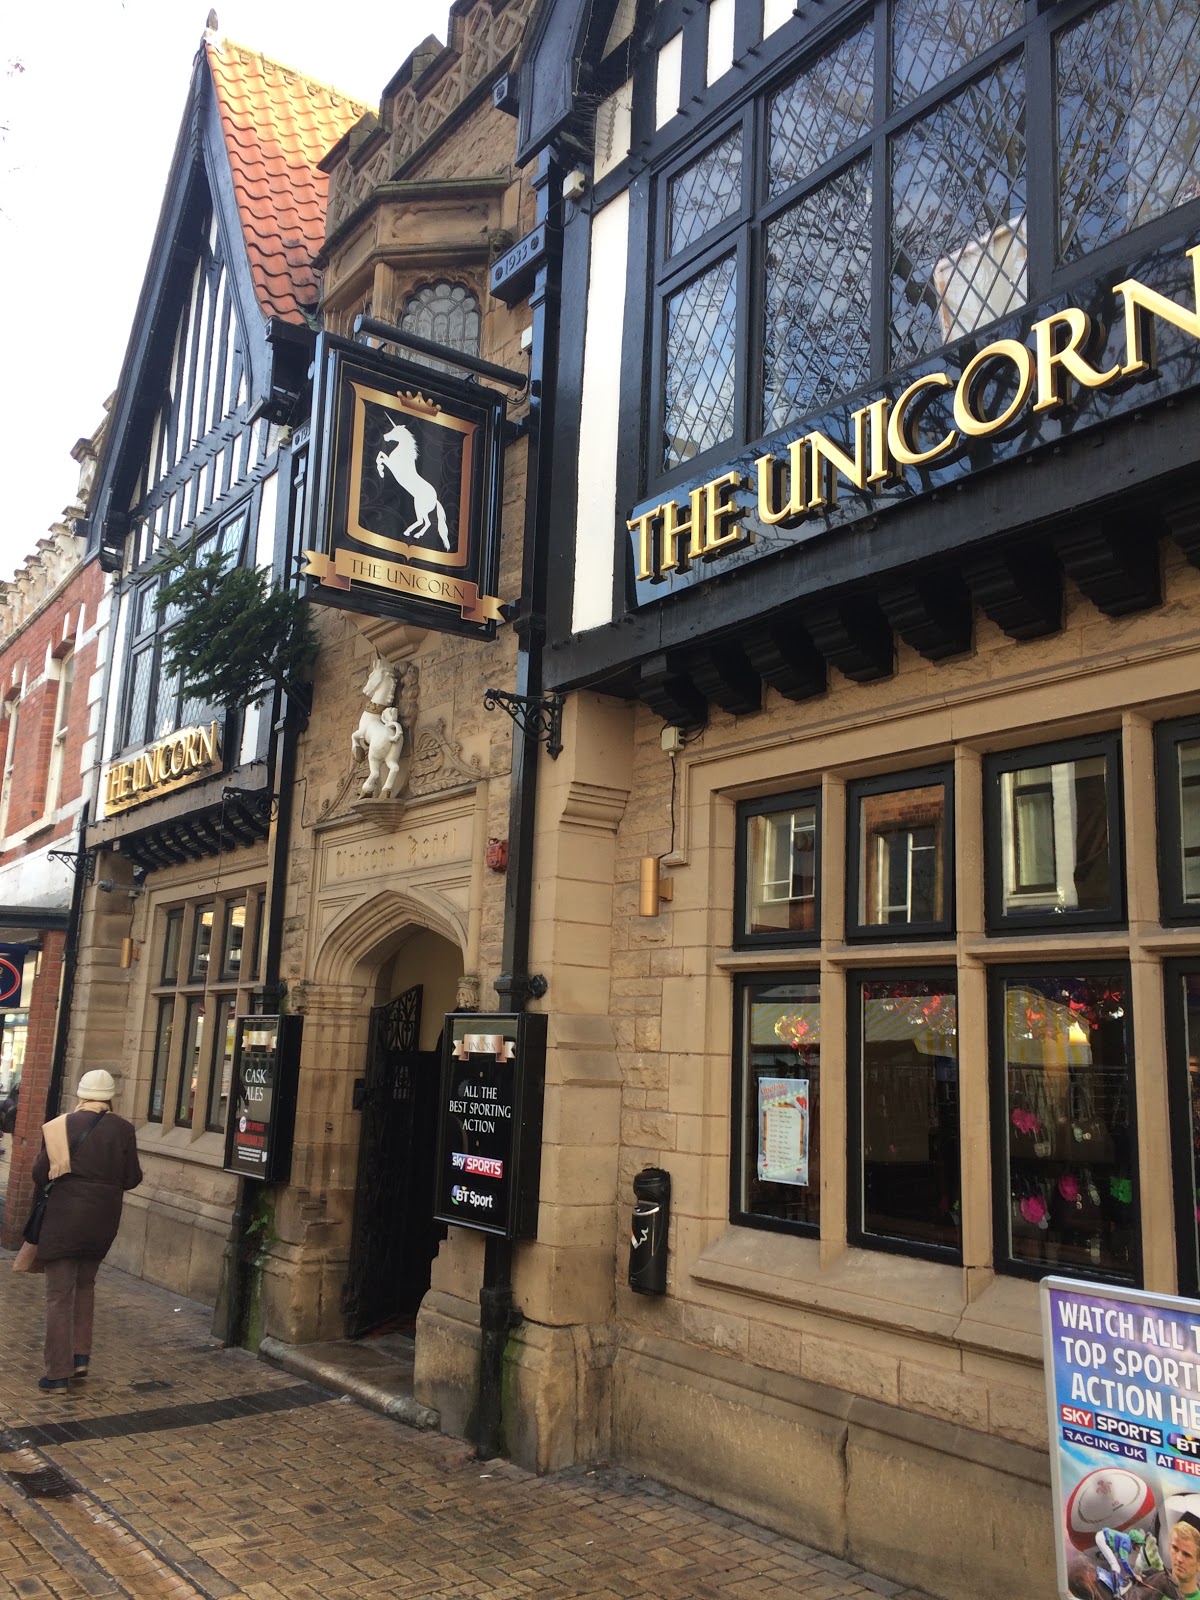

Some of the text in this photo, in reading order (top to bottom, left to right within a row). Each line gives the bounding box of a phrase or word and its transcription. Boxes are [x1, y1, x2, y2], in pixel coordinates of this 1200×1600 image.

[505, 244, 528, 275] 1933
[626, 245, 1200, 583] THE UNICORN
[350, 558, 465, 600] THE UNICORN
[105, 720, 219, 804] THE UNICORN
[245, 1068, 267, 1084] CASK
[244, 1086, 264, 1102] ALES
[463, 1085, 498, 1100] ALL THE
[449, 1100, 512, 1118] BEST SPORTING
[462, 1118, 496, 1134] ACTION
[452, 1154, 501, 1176] sky SPORTS
[456, 1189, 493, 1209] BT Sport
[1058, 1300, 1134, 1341] WATCH
[1142, 1316, 1184, 1351] ALL
[1061, 1336, 1107, 1370] TOP
[1071, 1372, 1200, 1431] ACTION HE
[1062, 1407, 1200, 1455] SKY SPORTS BT
[1064, 1429, 1145, 1460] RACING UK
[1157, 1454, 1200, 1476] AT THE
